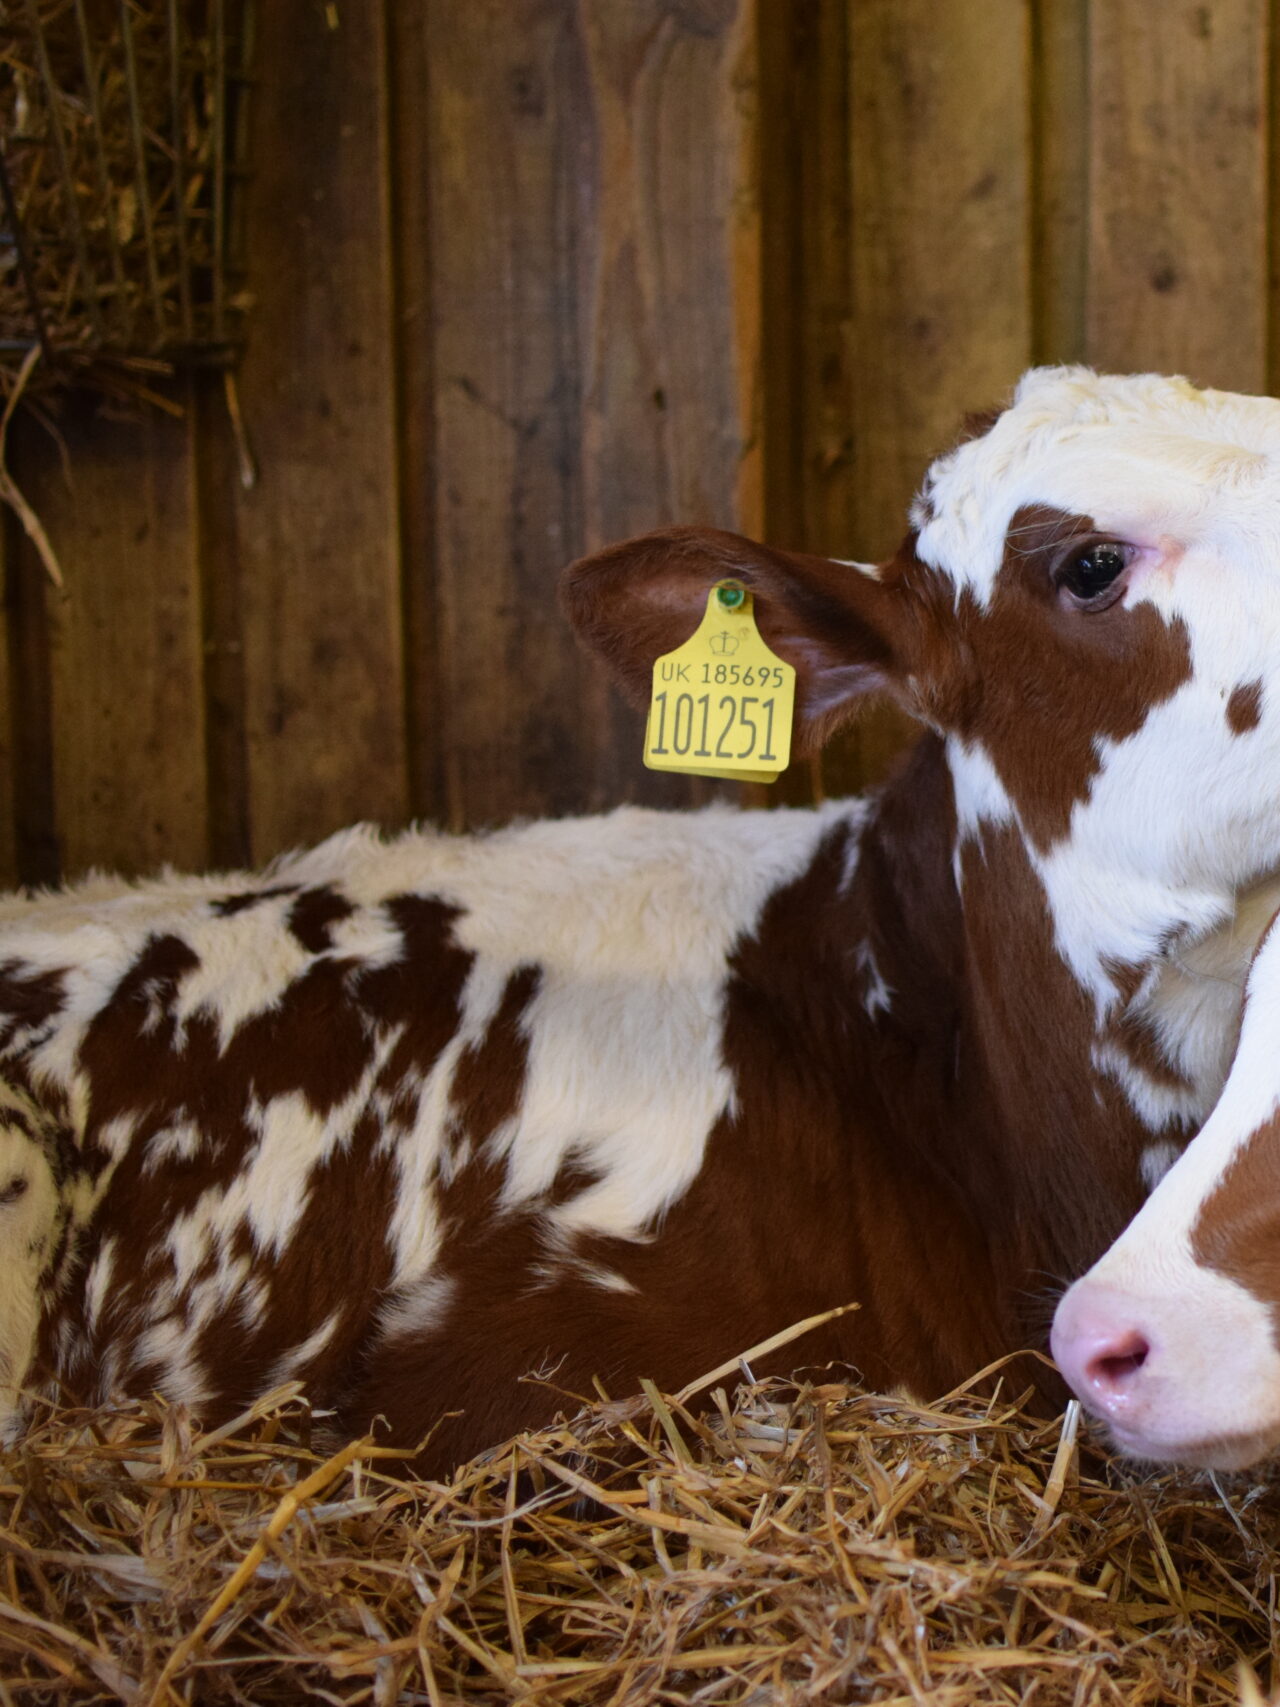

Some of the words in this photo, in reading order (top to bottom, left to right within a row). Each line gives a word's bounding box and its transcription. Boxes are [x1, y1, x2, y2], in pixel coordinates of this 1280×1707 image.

[661, 662, 692, 683] UK
[701, 662, 784, 689] 185695
[651, 690, 777, 761] 101251
